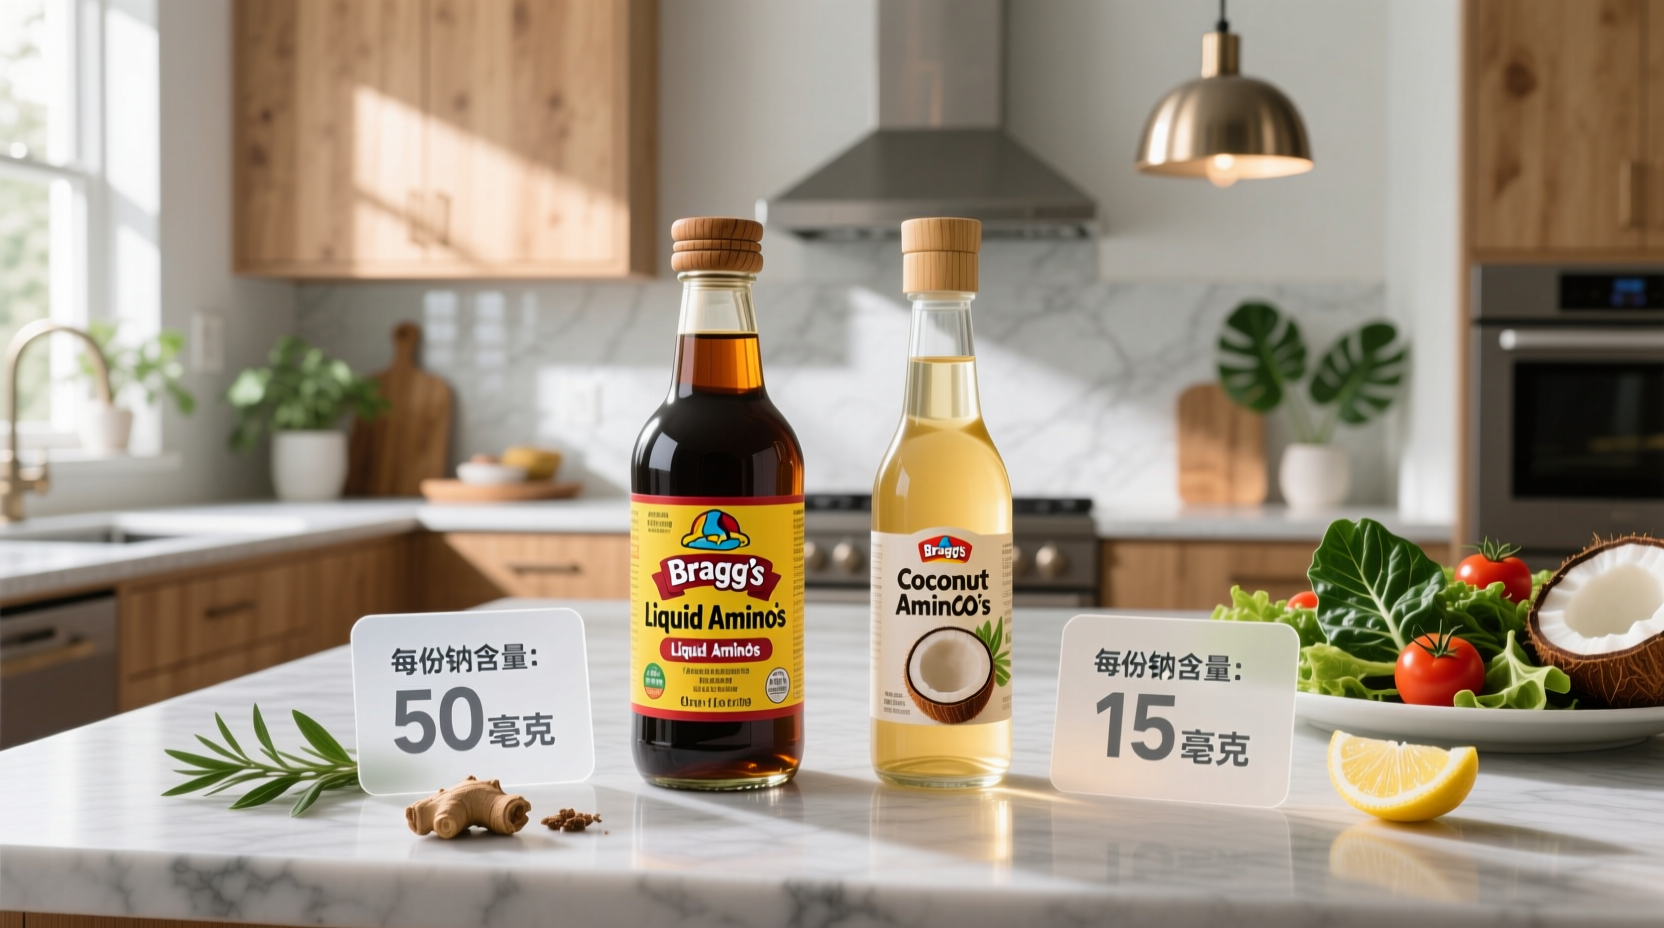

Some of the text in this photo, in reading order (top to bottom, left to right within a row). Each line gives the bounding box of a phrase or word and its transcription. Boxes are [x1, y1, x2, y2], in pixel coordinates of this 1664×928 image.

[667, 558, 765, 590] Bragg's
[897, 568, 989, 591] Coconut
[645, 601, 703, 634] Liquid
